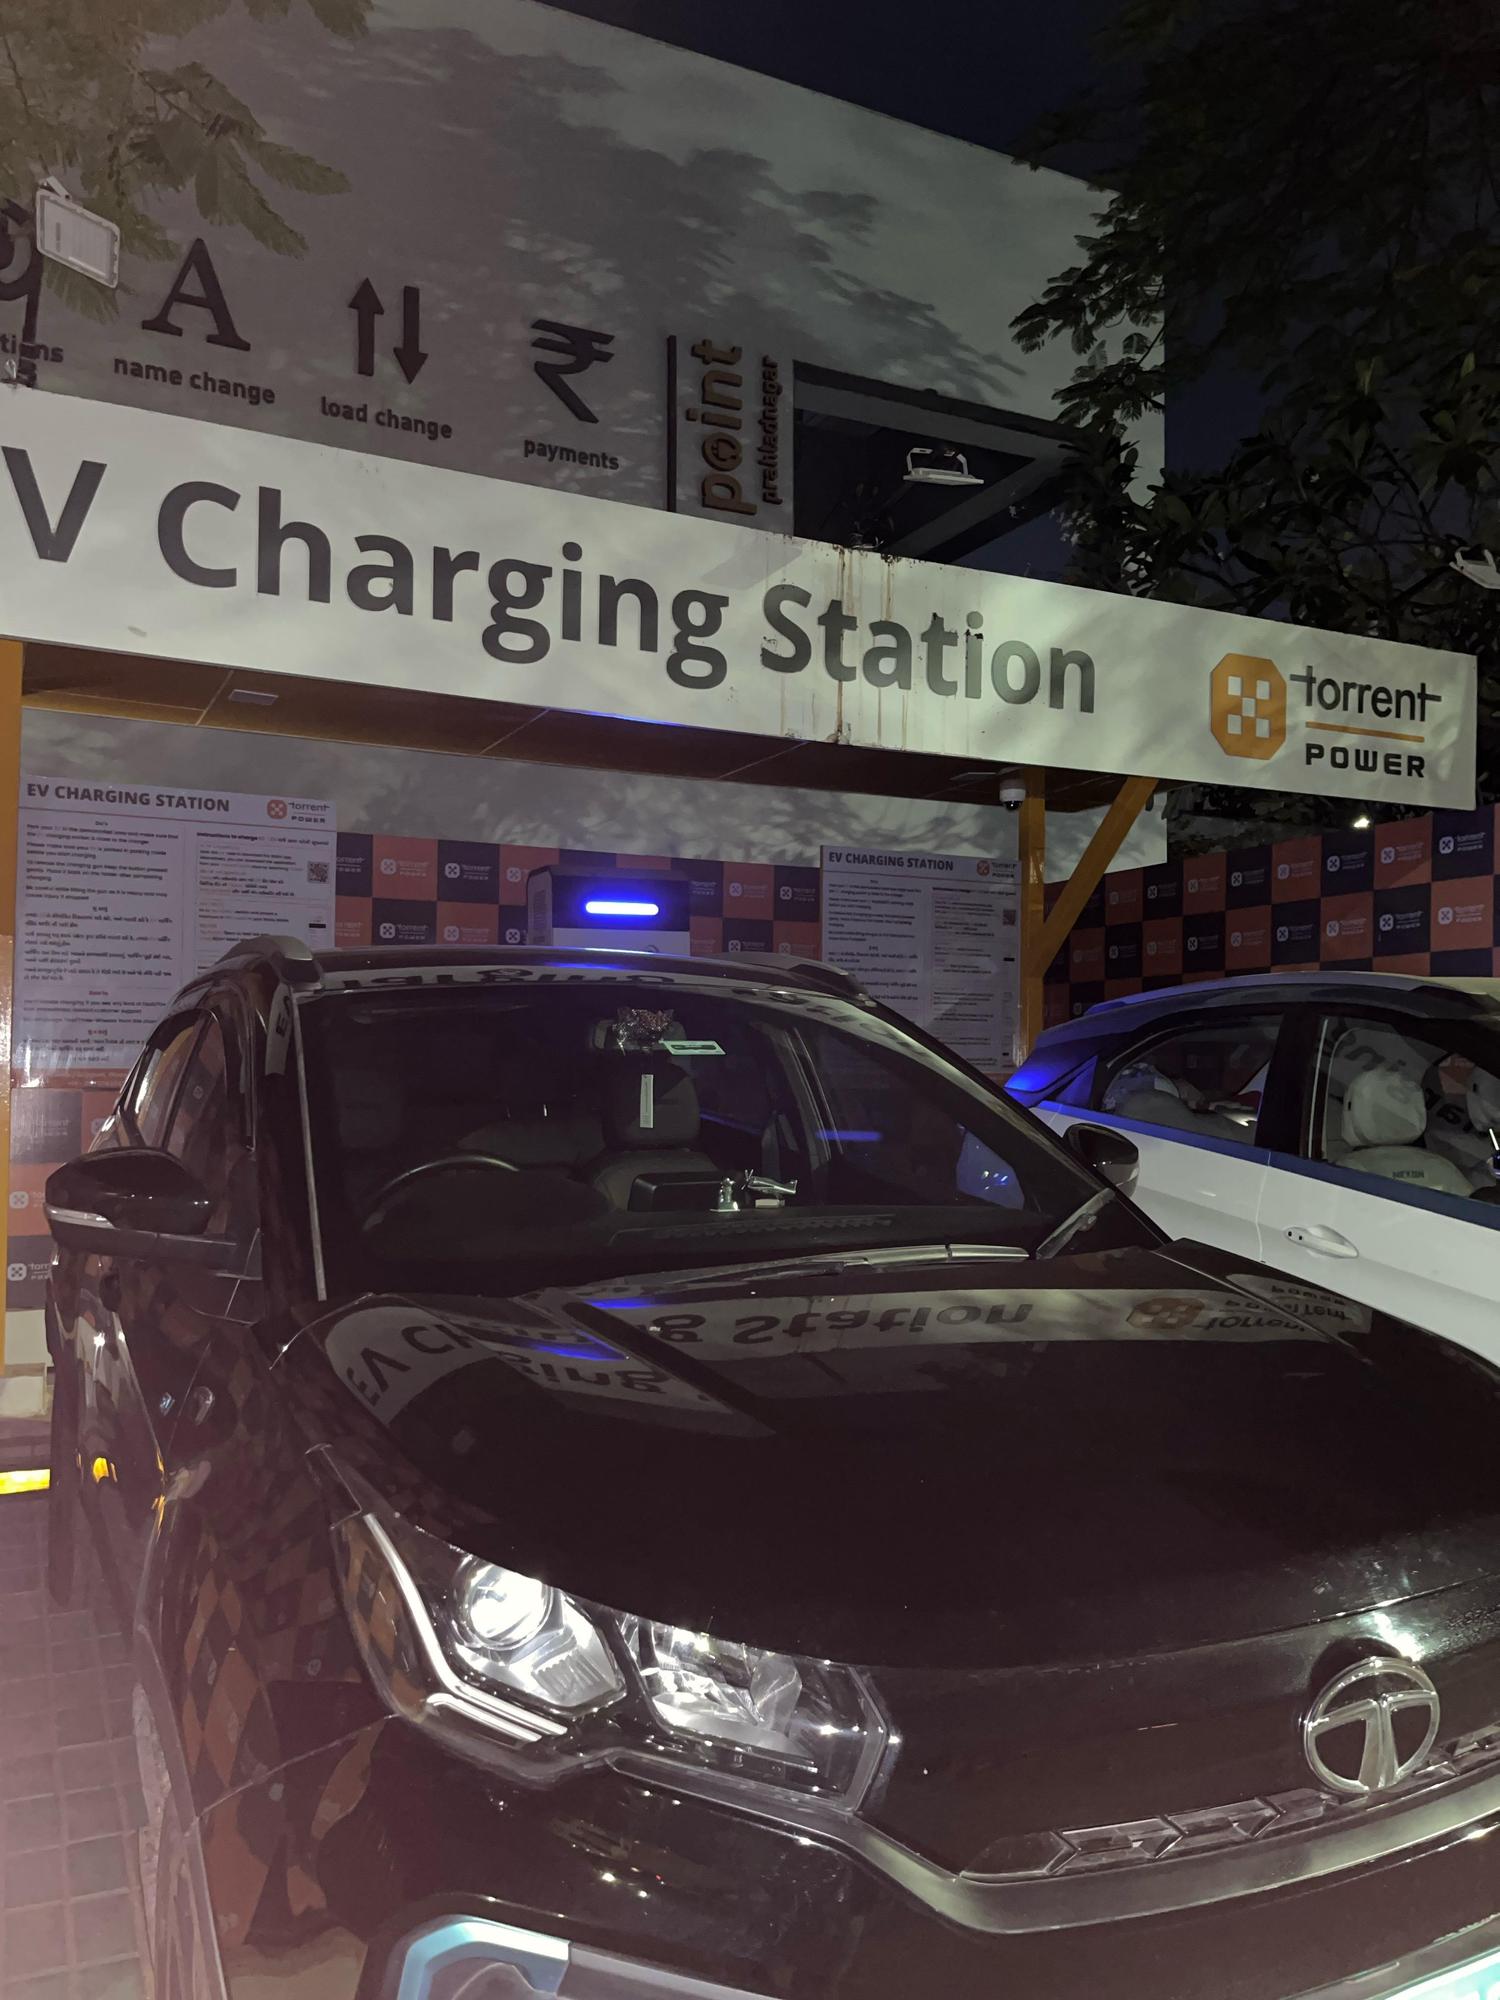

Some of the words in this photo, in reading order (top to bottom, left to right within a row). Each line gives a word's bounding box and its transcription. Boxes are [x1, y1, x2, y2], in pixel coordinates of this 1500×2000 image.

[113, 354, 183, 388] name
[189, 371, 276, 405] change
[321, 397, 368, 424] load
[375, 406, 453, 440] change
[684, 338, 757, 516] point
[756, 353, 784, 506] prahladnagar
[523, 437, 620, 472] payments
[1, 445, 107, 563] V
[157, 480, 729, 690] Charging
[760, 583, 1096, 714] Station
[1290, 665, 1442, 722] torrent
[1305, 742, 1425, 778] POWER
[26, 783, 49, 798] EV
[54, 785, 151, 806] CHARGING
[155, 794, 230, 812] STATION
[829, 852, 845, 864] EV
[846, 853, 904, 868] CHARGING
[907, 858, 954, 872] STATION
